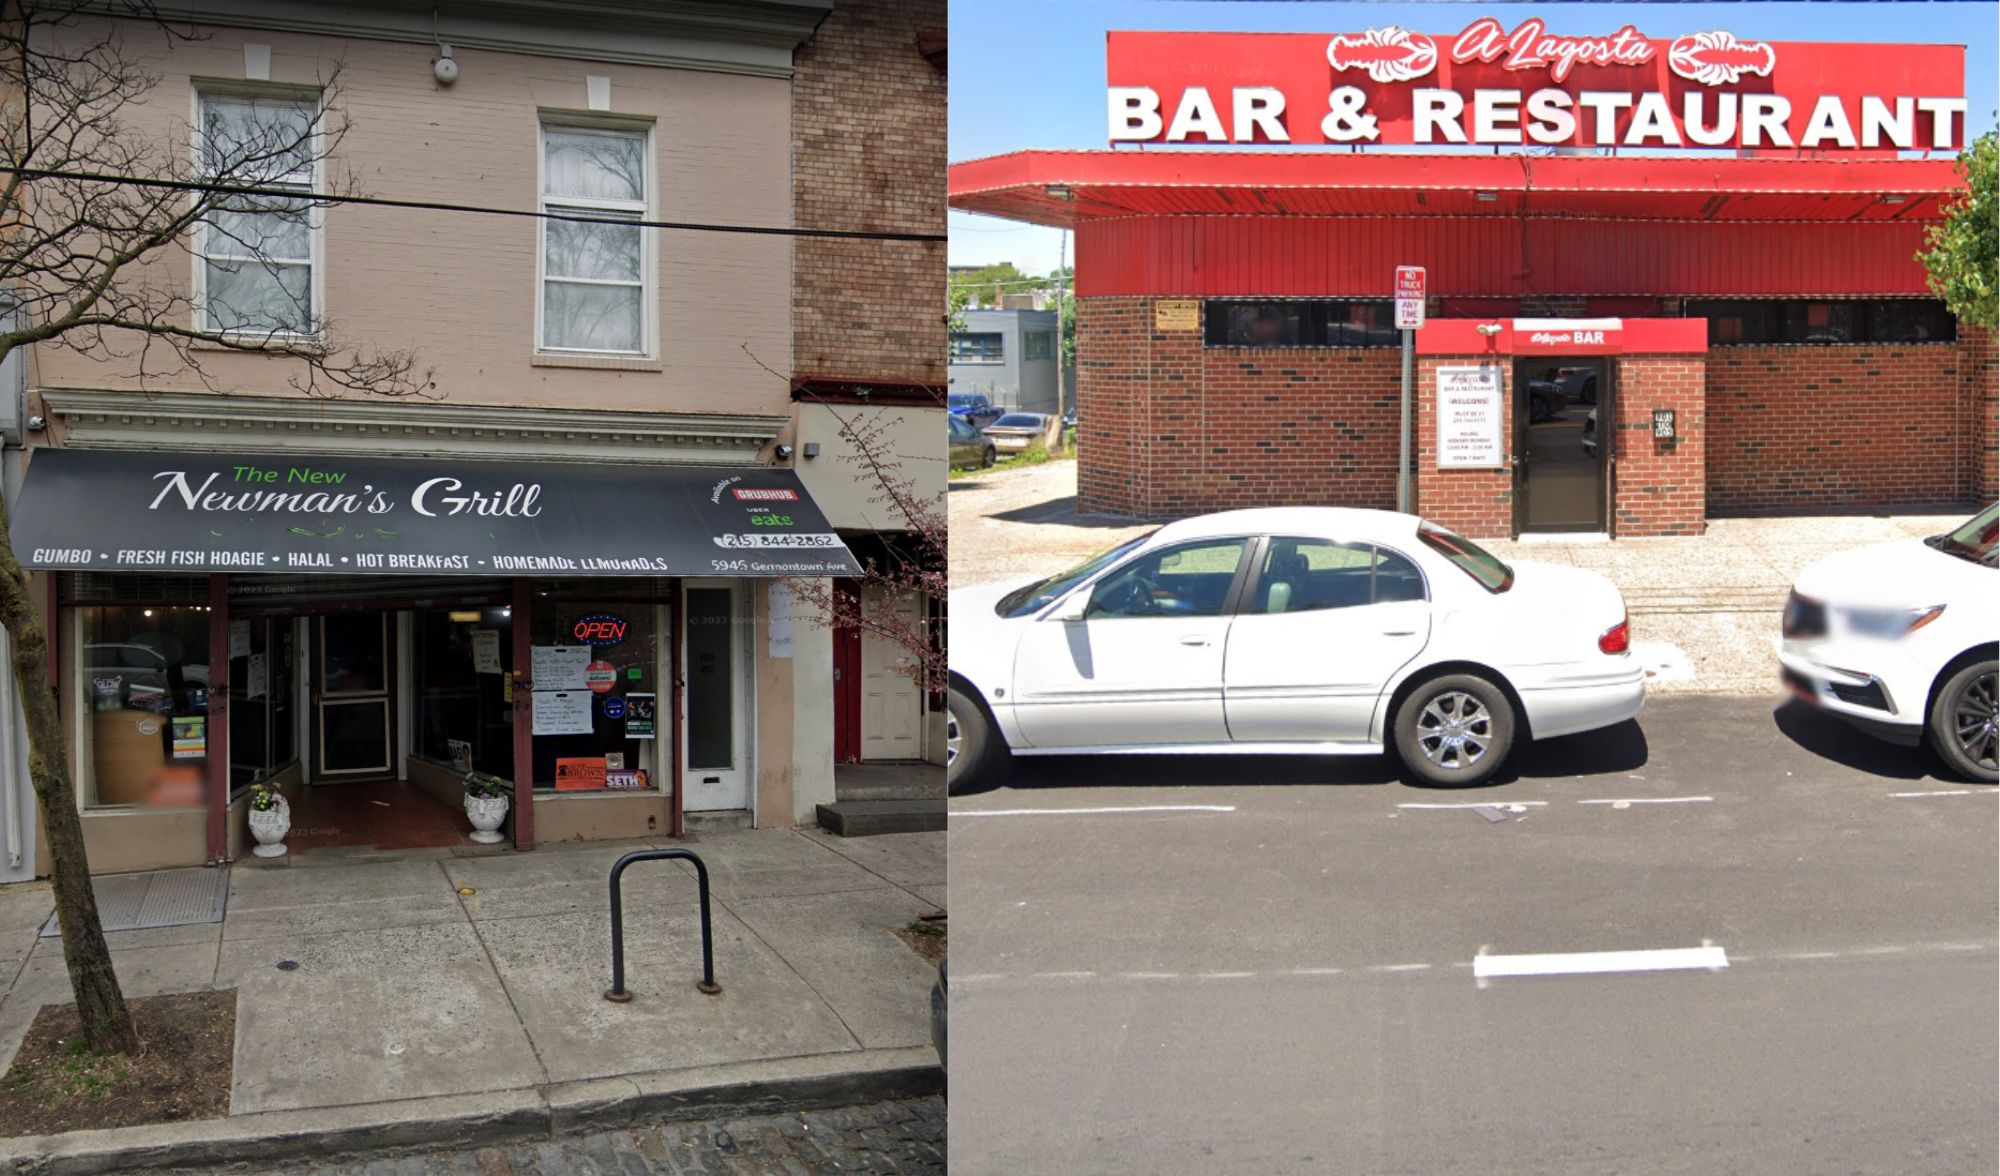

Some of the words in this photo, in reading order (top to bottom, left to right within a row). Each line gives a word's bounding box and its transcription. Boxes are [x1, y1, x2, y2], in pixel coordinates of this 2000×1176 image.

[1453, 21, 1501, 59] A
[1506, 21, 1654, 80] Lagosta
[1107, 86, 1290, 142] BAR
[1321, 86, 1380, 141] &
[1408, 88, 1968, 148] RESTAURANT
[1405, 271, 1416, 279] NO
[1402, 301, 1418, 309] ANY
[1402, 310, 1418, 318] TIME
[1574, 331, 1604, 344] BAR
[233, 466, 278, 483] The
[287, 468, 346, 484] New
[148, 471, 394, 514] Newman's
[411, 477, 542, 517] Grill
[737, 490, 793, 499] GRUBHUB
[751, 514, 794, 526] eats
[722, 534, 757, 547] (215)
[761, 535, 834, 547] 844-2862
[33, 548, 92, 564] GUMBO
[117, 550, 166, 564] FRESH
[171, 551, 205, 565] FISH
[210, 552, 265, 566] HOAGIE
[288, 552, 334, 567] HALAL
[356, 553, 384, 567] HOT
[493, 555, 577, 570] HOMEMADE
[751, 562, 824, 571] Germantown
[827, 562, 847, 571] Ave
[575, 623, 627, 639] OPEN
[568, 768, 604, 777] BROWN
[606, 775, 638, 786] SETH
